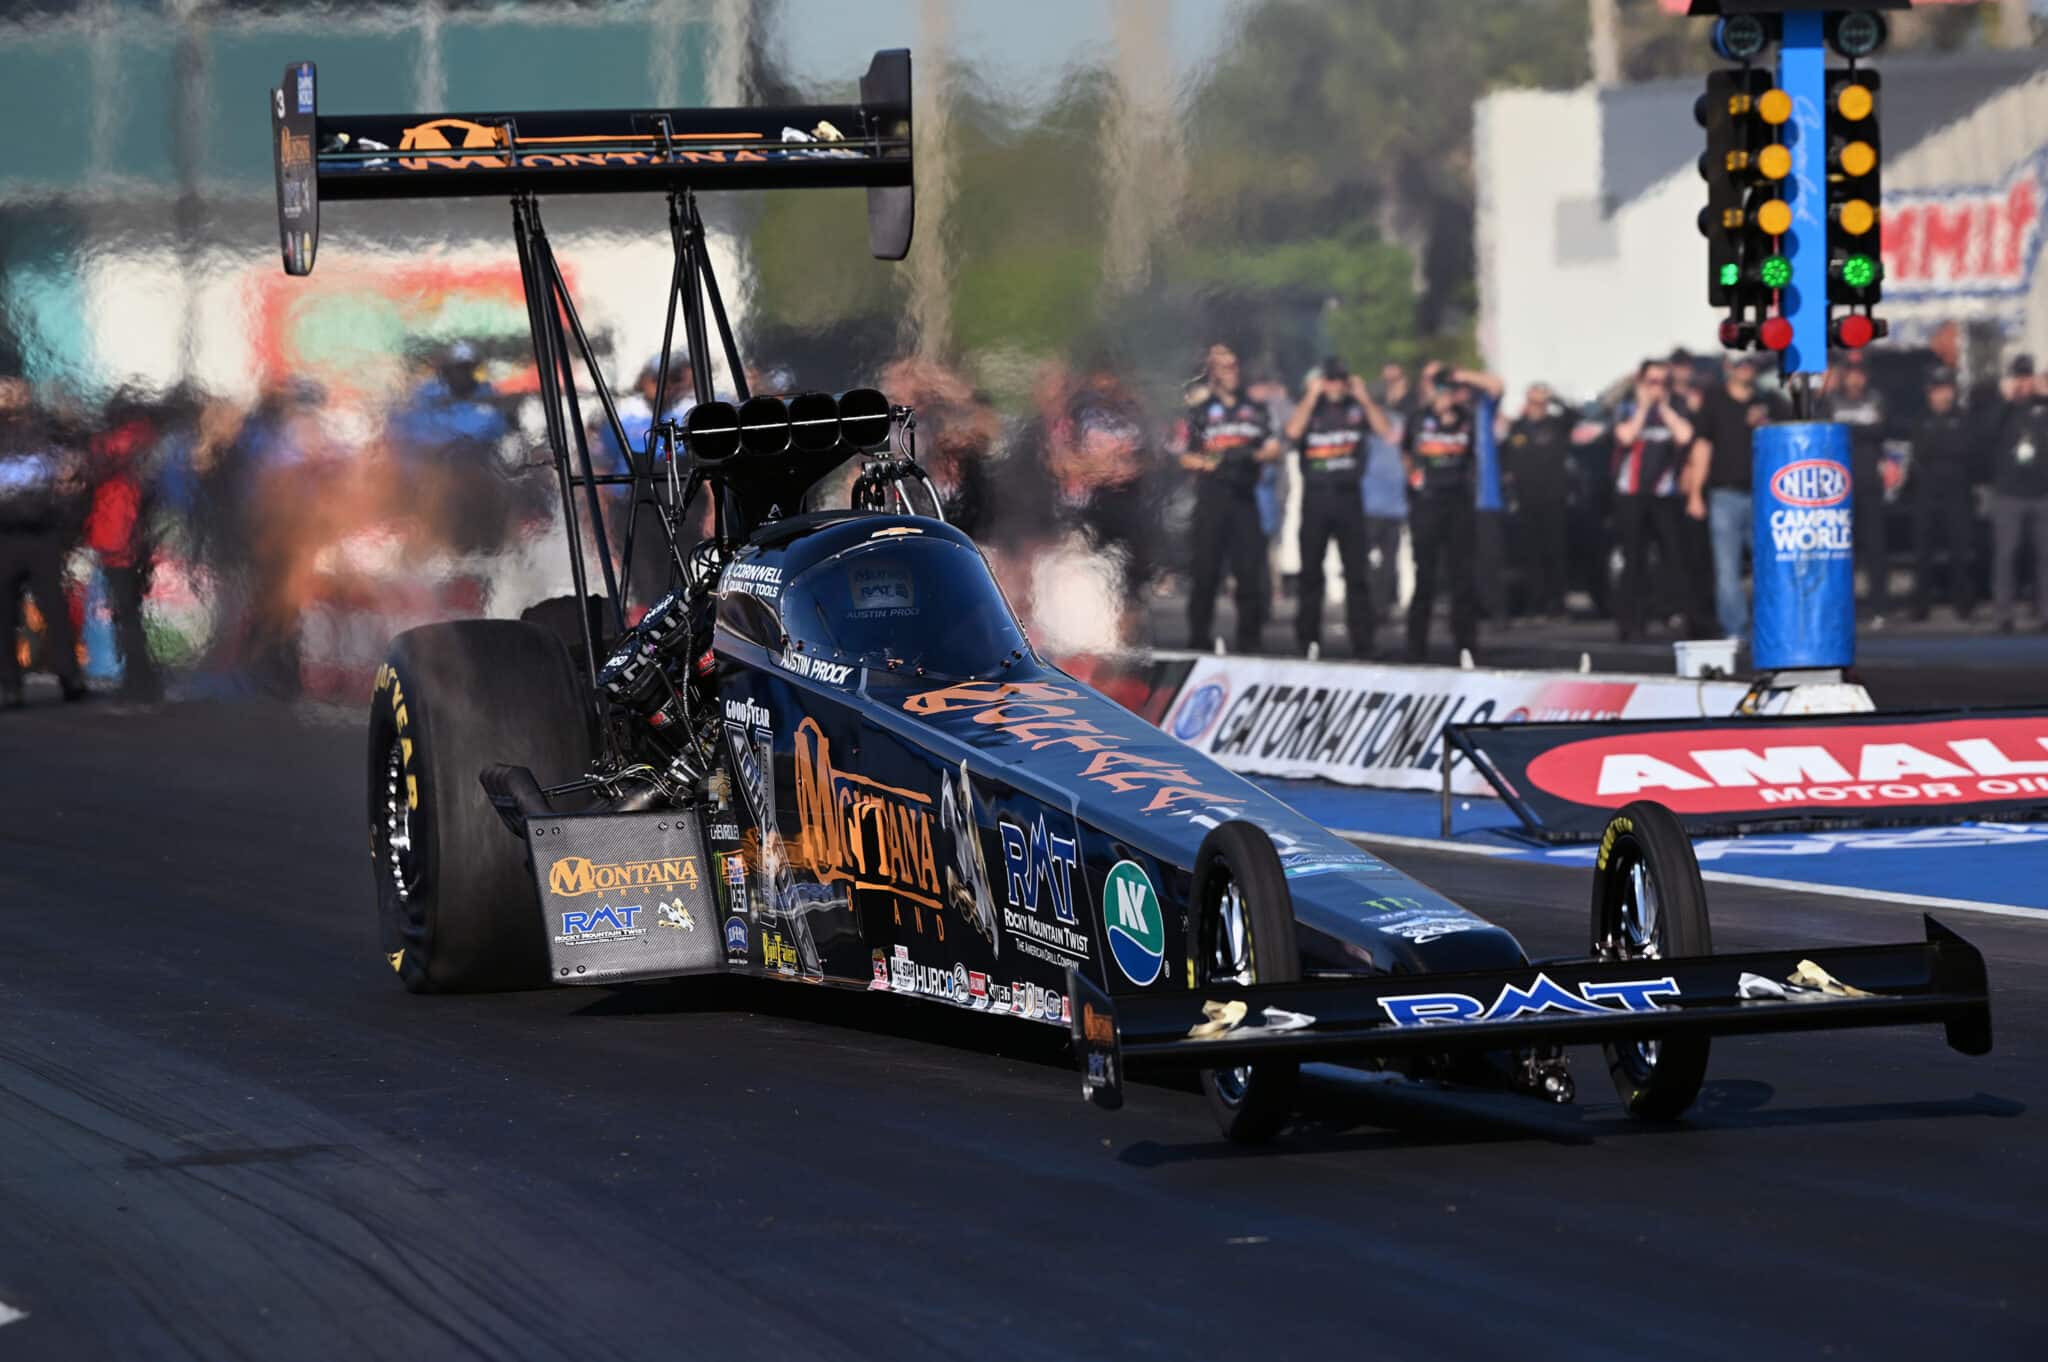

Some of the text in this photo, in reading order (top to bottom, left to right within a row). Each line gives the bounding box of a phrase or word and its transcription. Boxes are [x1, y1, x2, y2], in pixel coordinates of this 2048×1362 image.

[275, 88, 286, 119] 3
[1778, 465, 1844, 498] NHRA
[1772, 527, 1851, 551] WORLD
[728, 580, 779, 598] QUALITY TOOLS
[732, 563, 783, 584] CORNWELL
[780, 649, 854, 685] AUSTIN PROCK
[725, 698, 770, 728] GOODYEAR
[1597, 737, 2048, 795] AMAL
[1759, 782, 1963, 803] MOTOR
[550, 856, 698, 896] MONTANA
[1000, 812, 1077, 925] RMT
[561, 903, 642, 935] RMT
[846, 886, 944, 942] BAND
[1004, 907, 1089, 953] ROCKY MOUNTAIN TWIST
[915, 964, 955, 999] HURCO
[1376, 973, 1682, 1026] RMT
